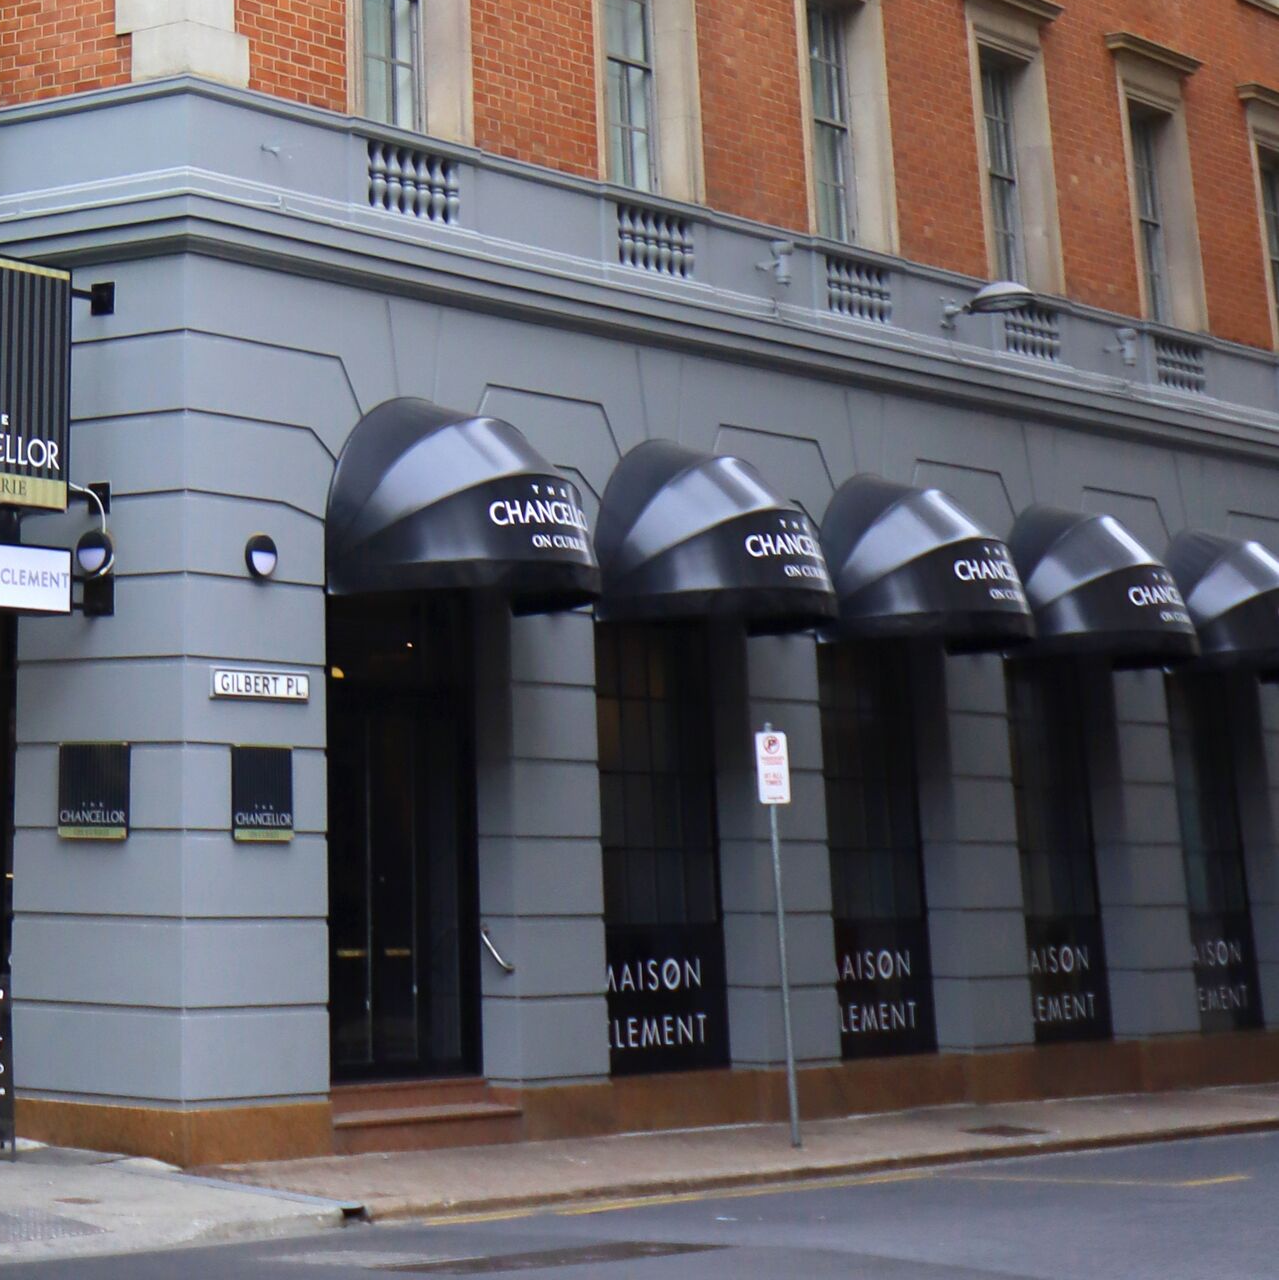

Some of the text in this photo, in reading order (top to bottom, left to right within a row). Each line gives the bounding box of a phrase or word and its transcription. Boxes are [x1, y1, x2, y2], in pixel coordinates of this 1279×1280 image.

[489, 498, 589, 532] CHANCELLO
[531, 534, 553, 548] ON
[0, 567, 70, 589] CLEMENT
[221, 673, 279, 695] GILBERT
[60, 809, 127, 824] CHANCELLOR
[234, 811, 293, 827] CHANCELLOR
[841, 949, 912, 981] AISON
[1030, 945, 1090, 974] AISON
[840, 1001, 916, 1033] LEMENT
[1036, 992, 1096, 1022] EMENT
[608, 1013, 707, 1049] LEMENT
